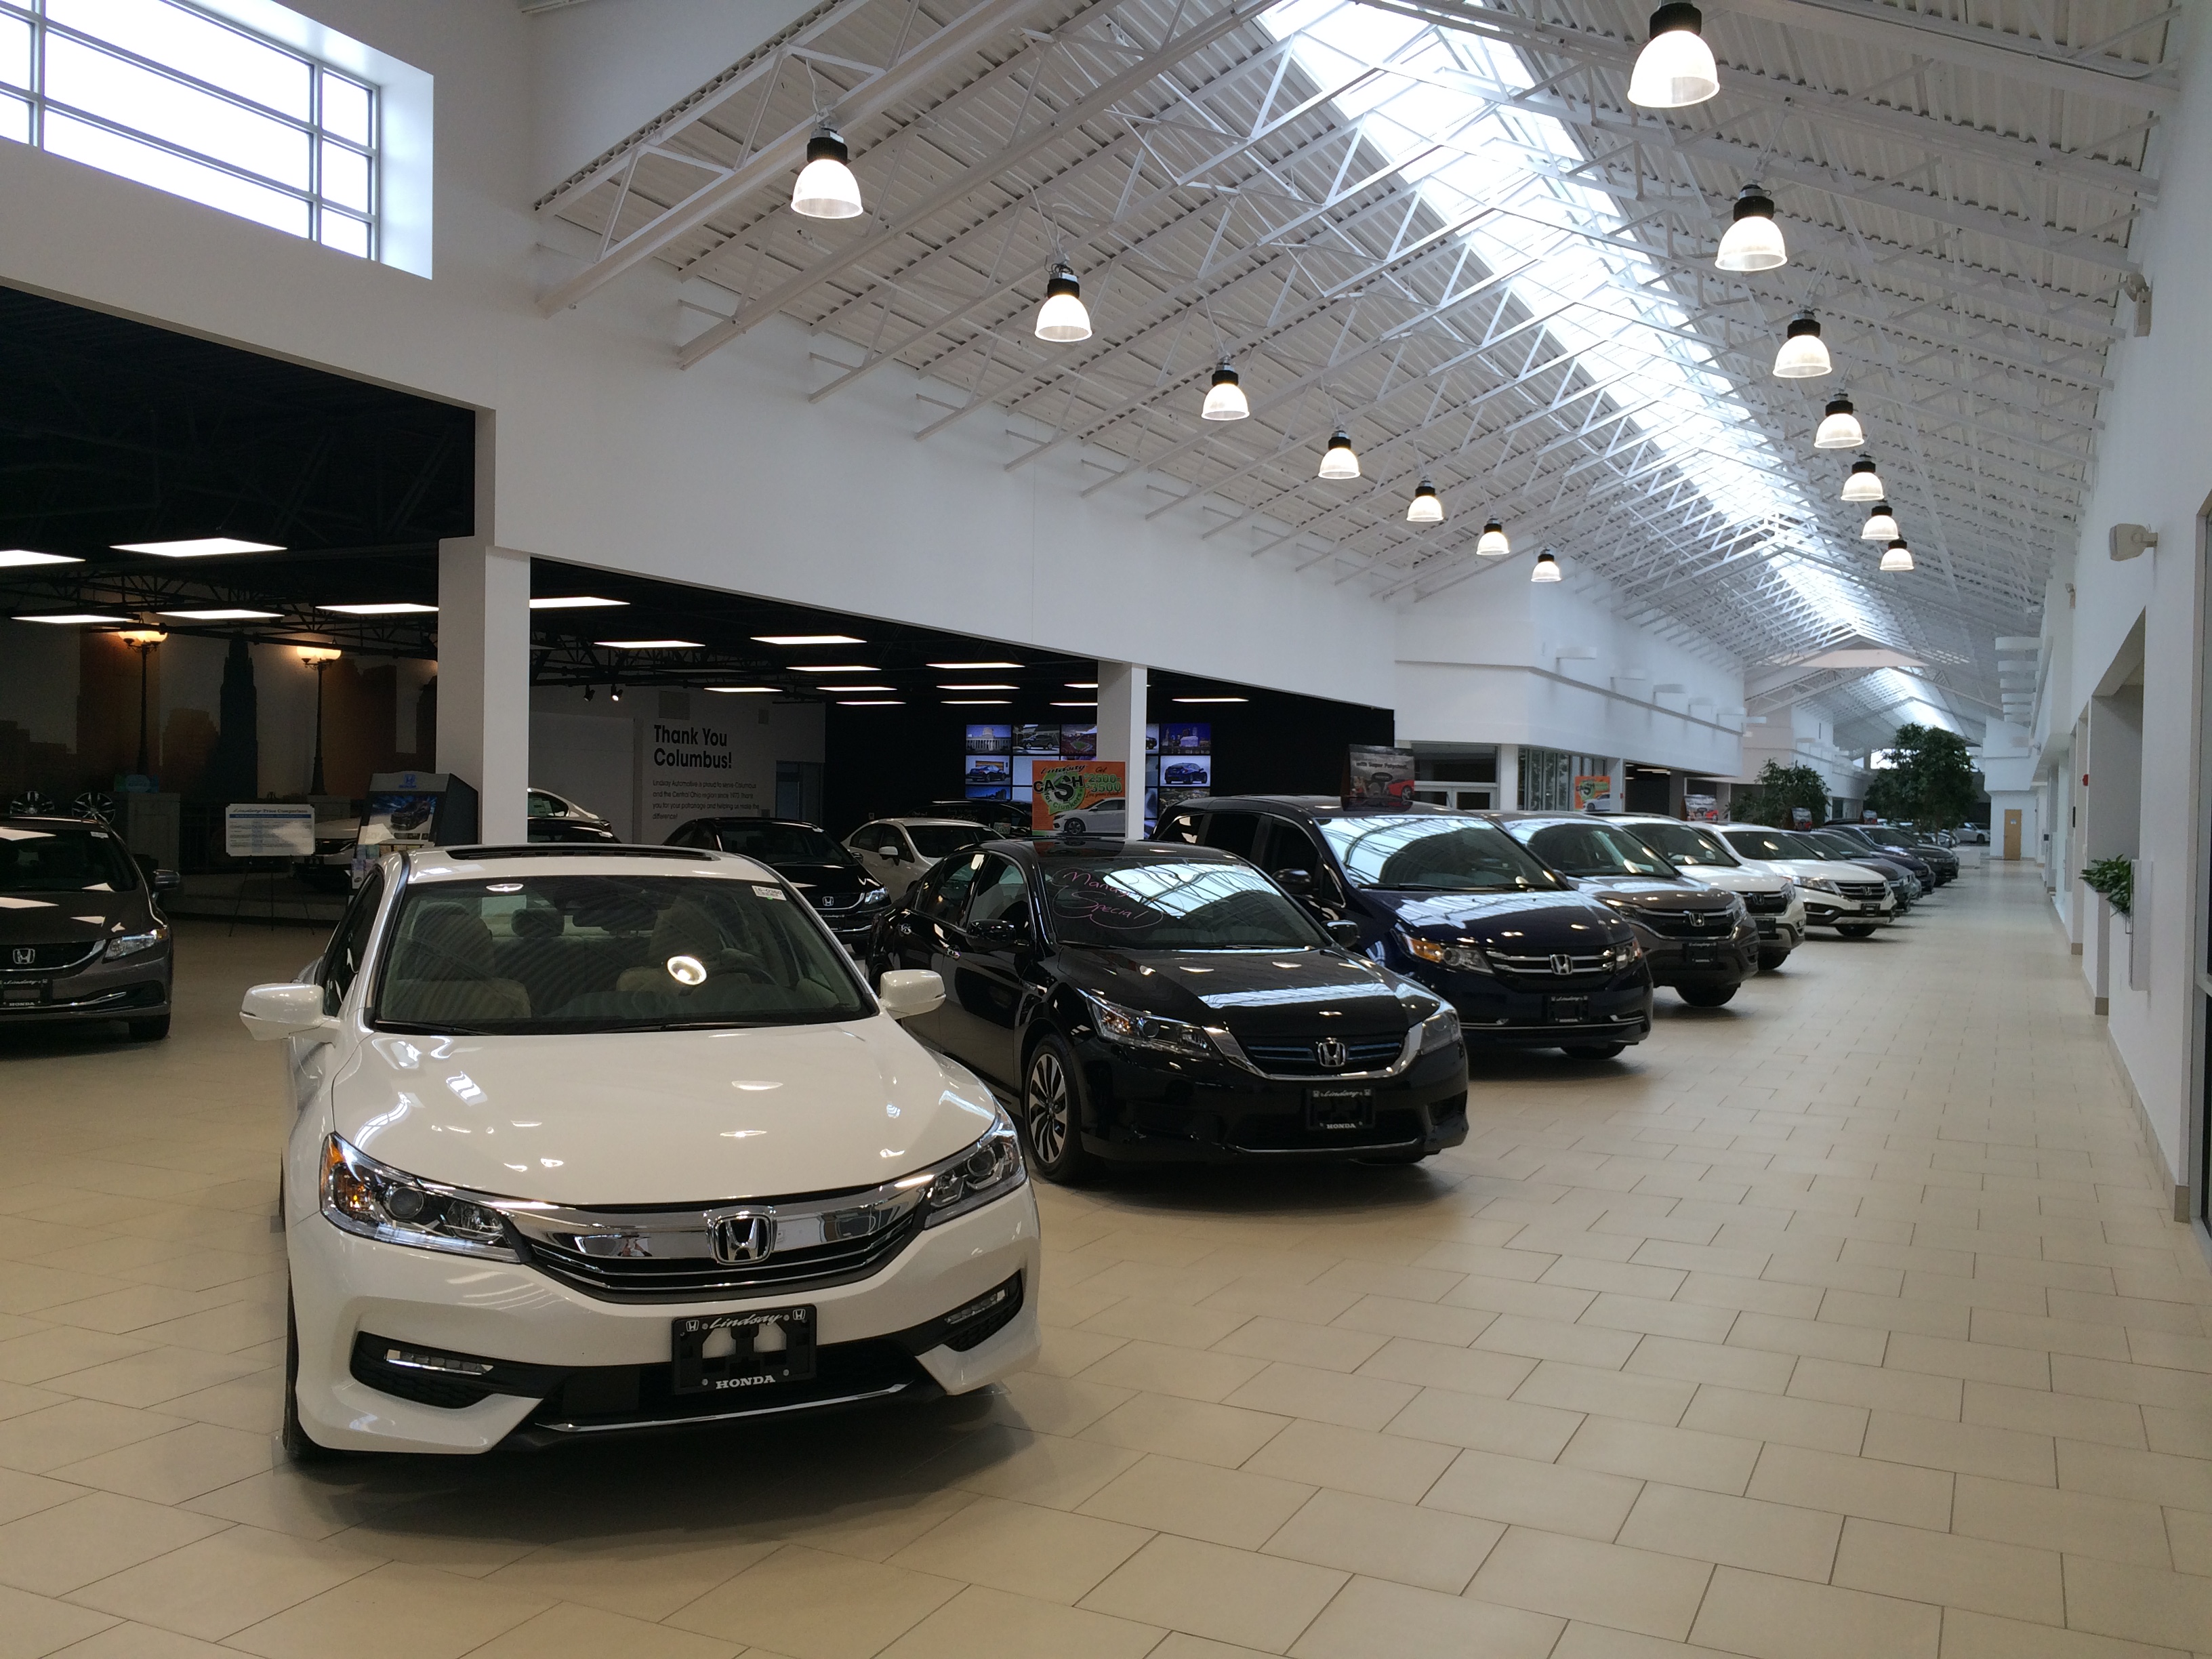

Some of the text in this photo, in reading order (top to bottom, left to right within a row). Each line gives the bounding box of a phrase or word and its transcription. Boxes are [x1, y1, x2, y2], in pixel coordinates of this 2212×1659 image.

[654, 724, 727, 746] Thank You
[654, 747, 732, 769] Columbus!
[709, 1313, 783, 1329] Lindsay
[715, 1374, 776, 1389] HONDA
